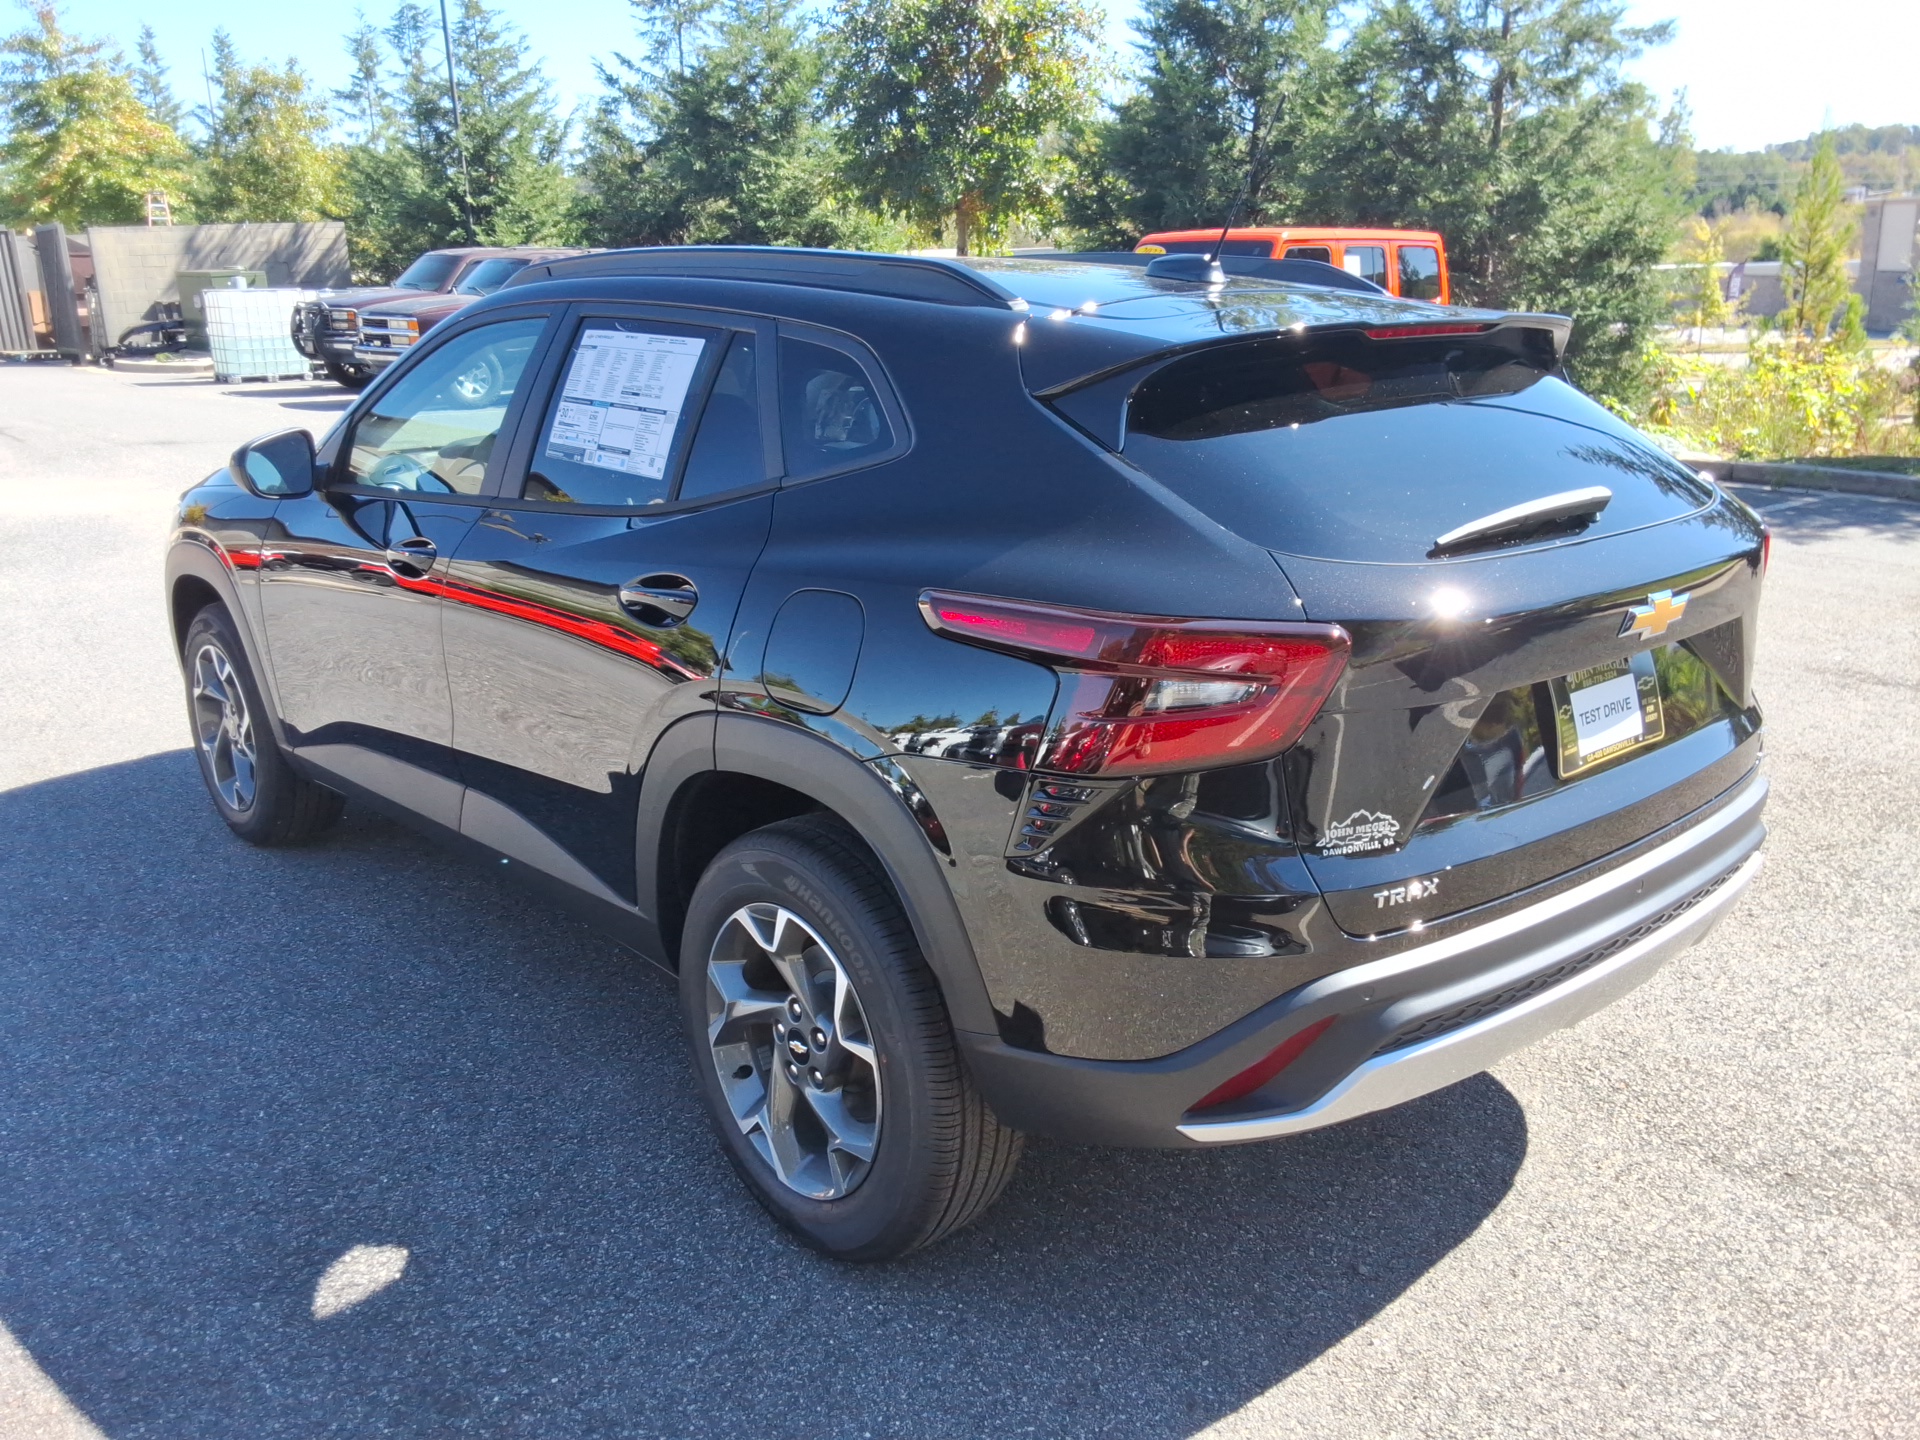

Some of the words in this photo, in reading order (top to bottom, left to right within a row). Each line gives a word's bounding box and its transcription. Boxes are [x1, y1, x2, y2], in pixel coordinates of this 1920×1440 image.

[1579, 705, 1602, 727] TEST
[1604, 697, 1632, 719] DRIVE
[1325, 826, 1354, 843] JOHN
[1355, 820, 1391, 834] MEGEL
[1322, 841, 1381, 856] DAWSONVILLE,
[1383, 837, 1395, 847] GA
[1372, 877, 1440, 909] TRAX
